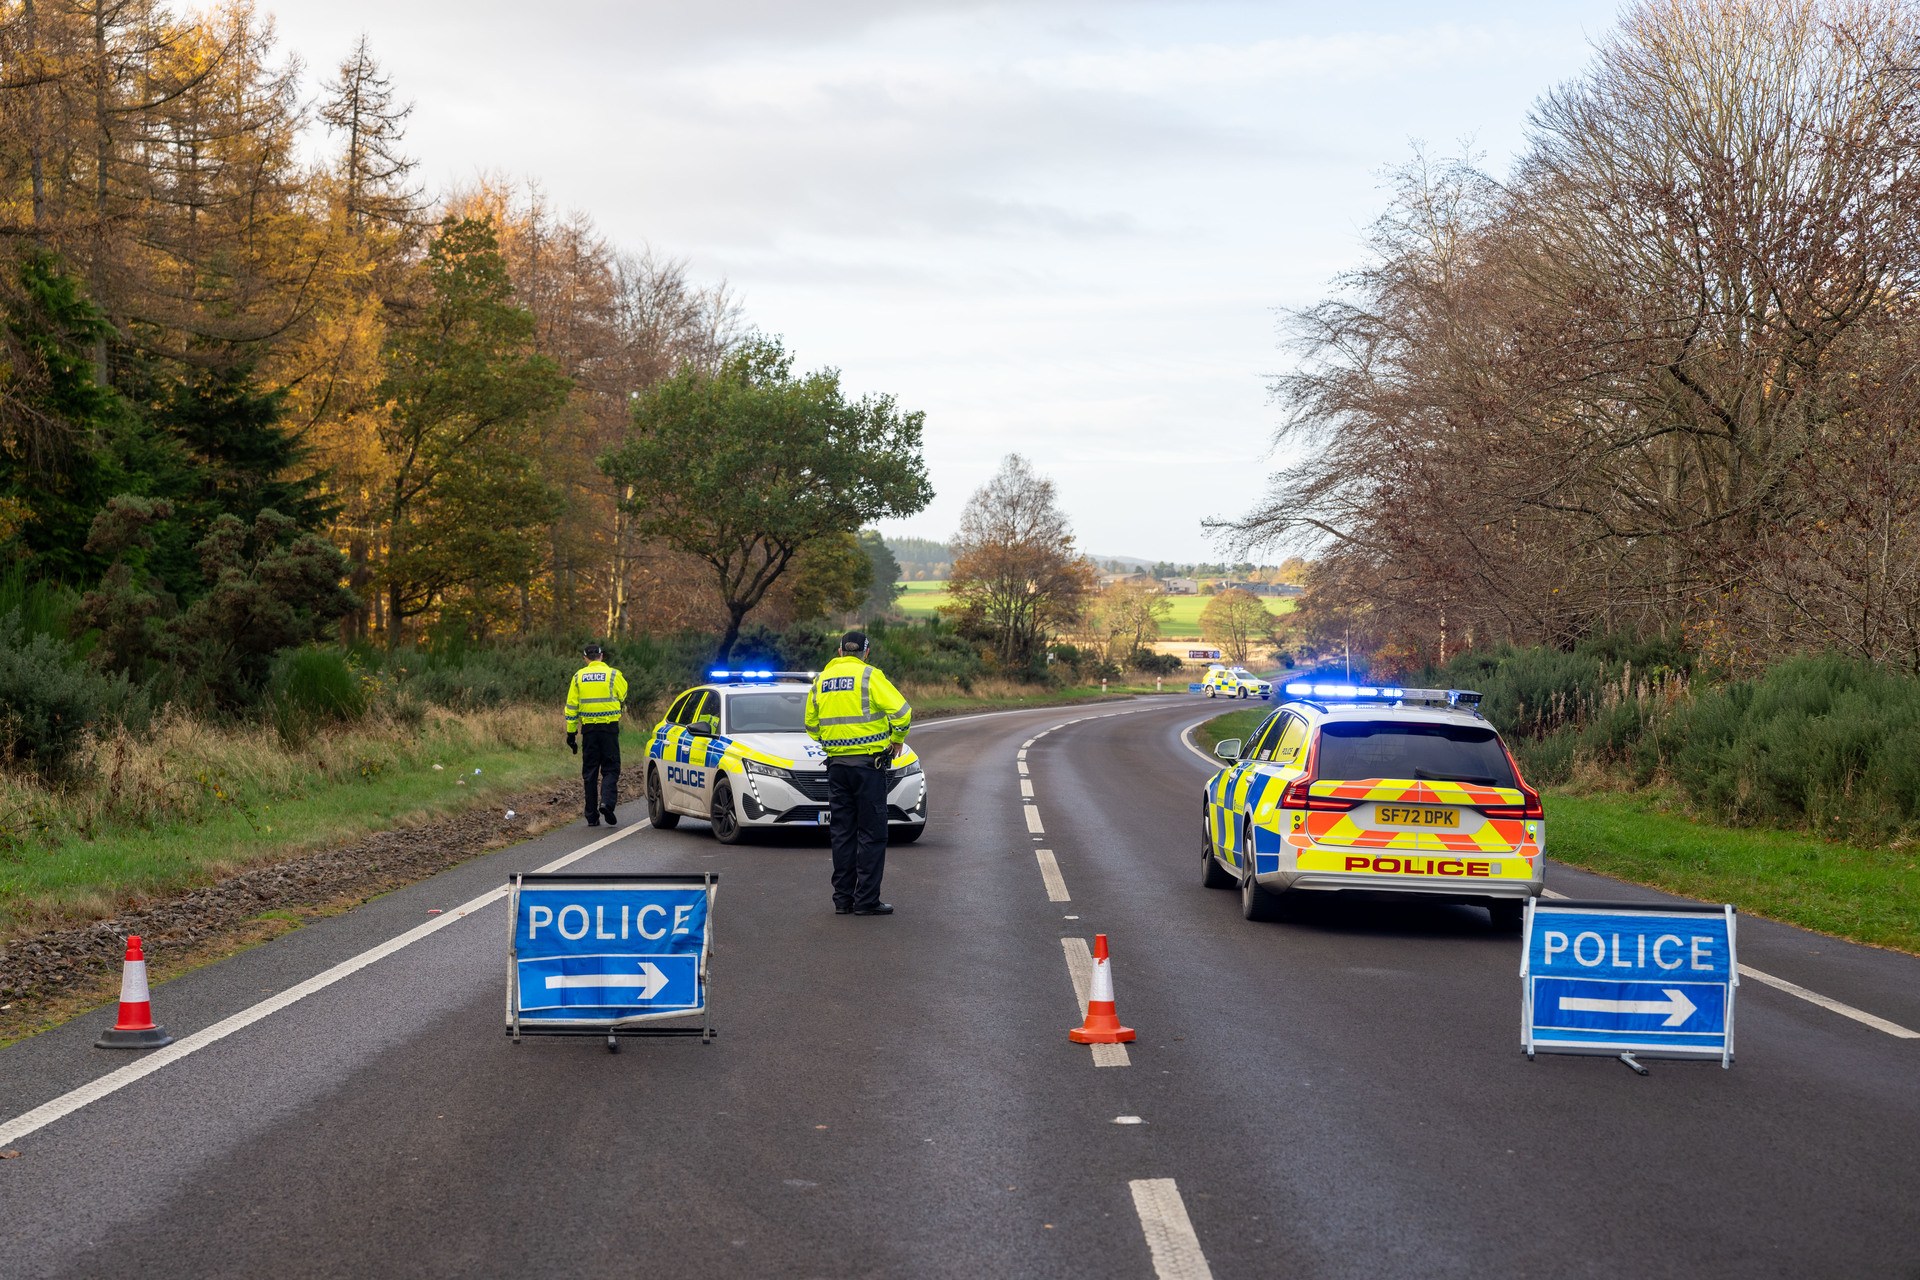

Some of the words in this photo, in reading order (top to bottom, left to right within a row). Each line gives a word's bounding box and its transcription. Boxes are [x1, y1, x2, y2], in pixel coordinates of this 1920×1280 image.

[582, 673, 605, 681] POLICE
[822, 678, 853, 692] POLICE
[667, 766, 705, 788] POLICE
[1381, 808, 1420, 823] SF72
[1424, 810, 1453, 825] DPK
[1345, 856, 1490, 877] POLICE
[529, 904, 695, 940] POLICE
[1544, 931, 1714, 971] POLICE
